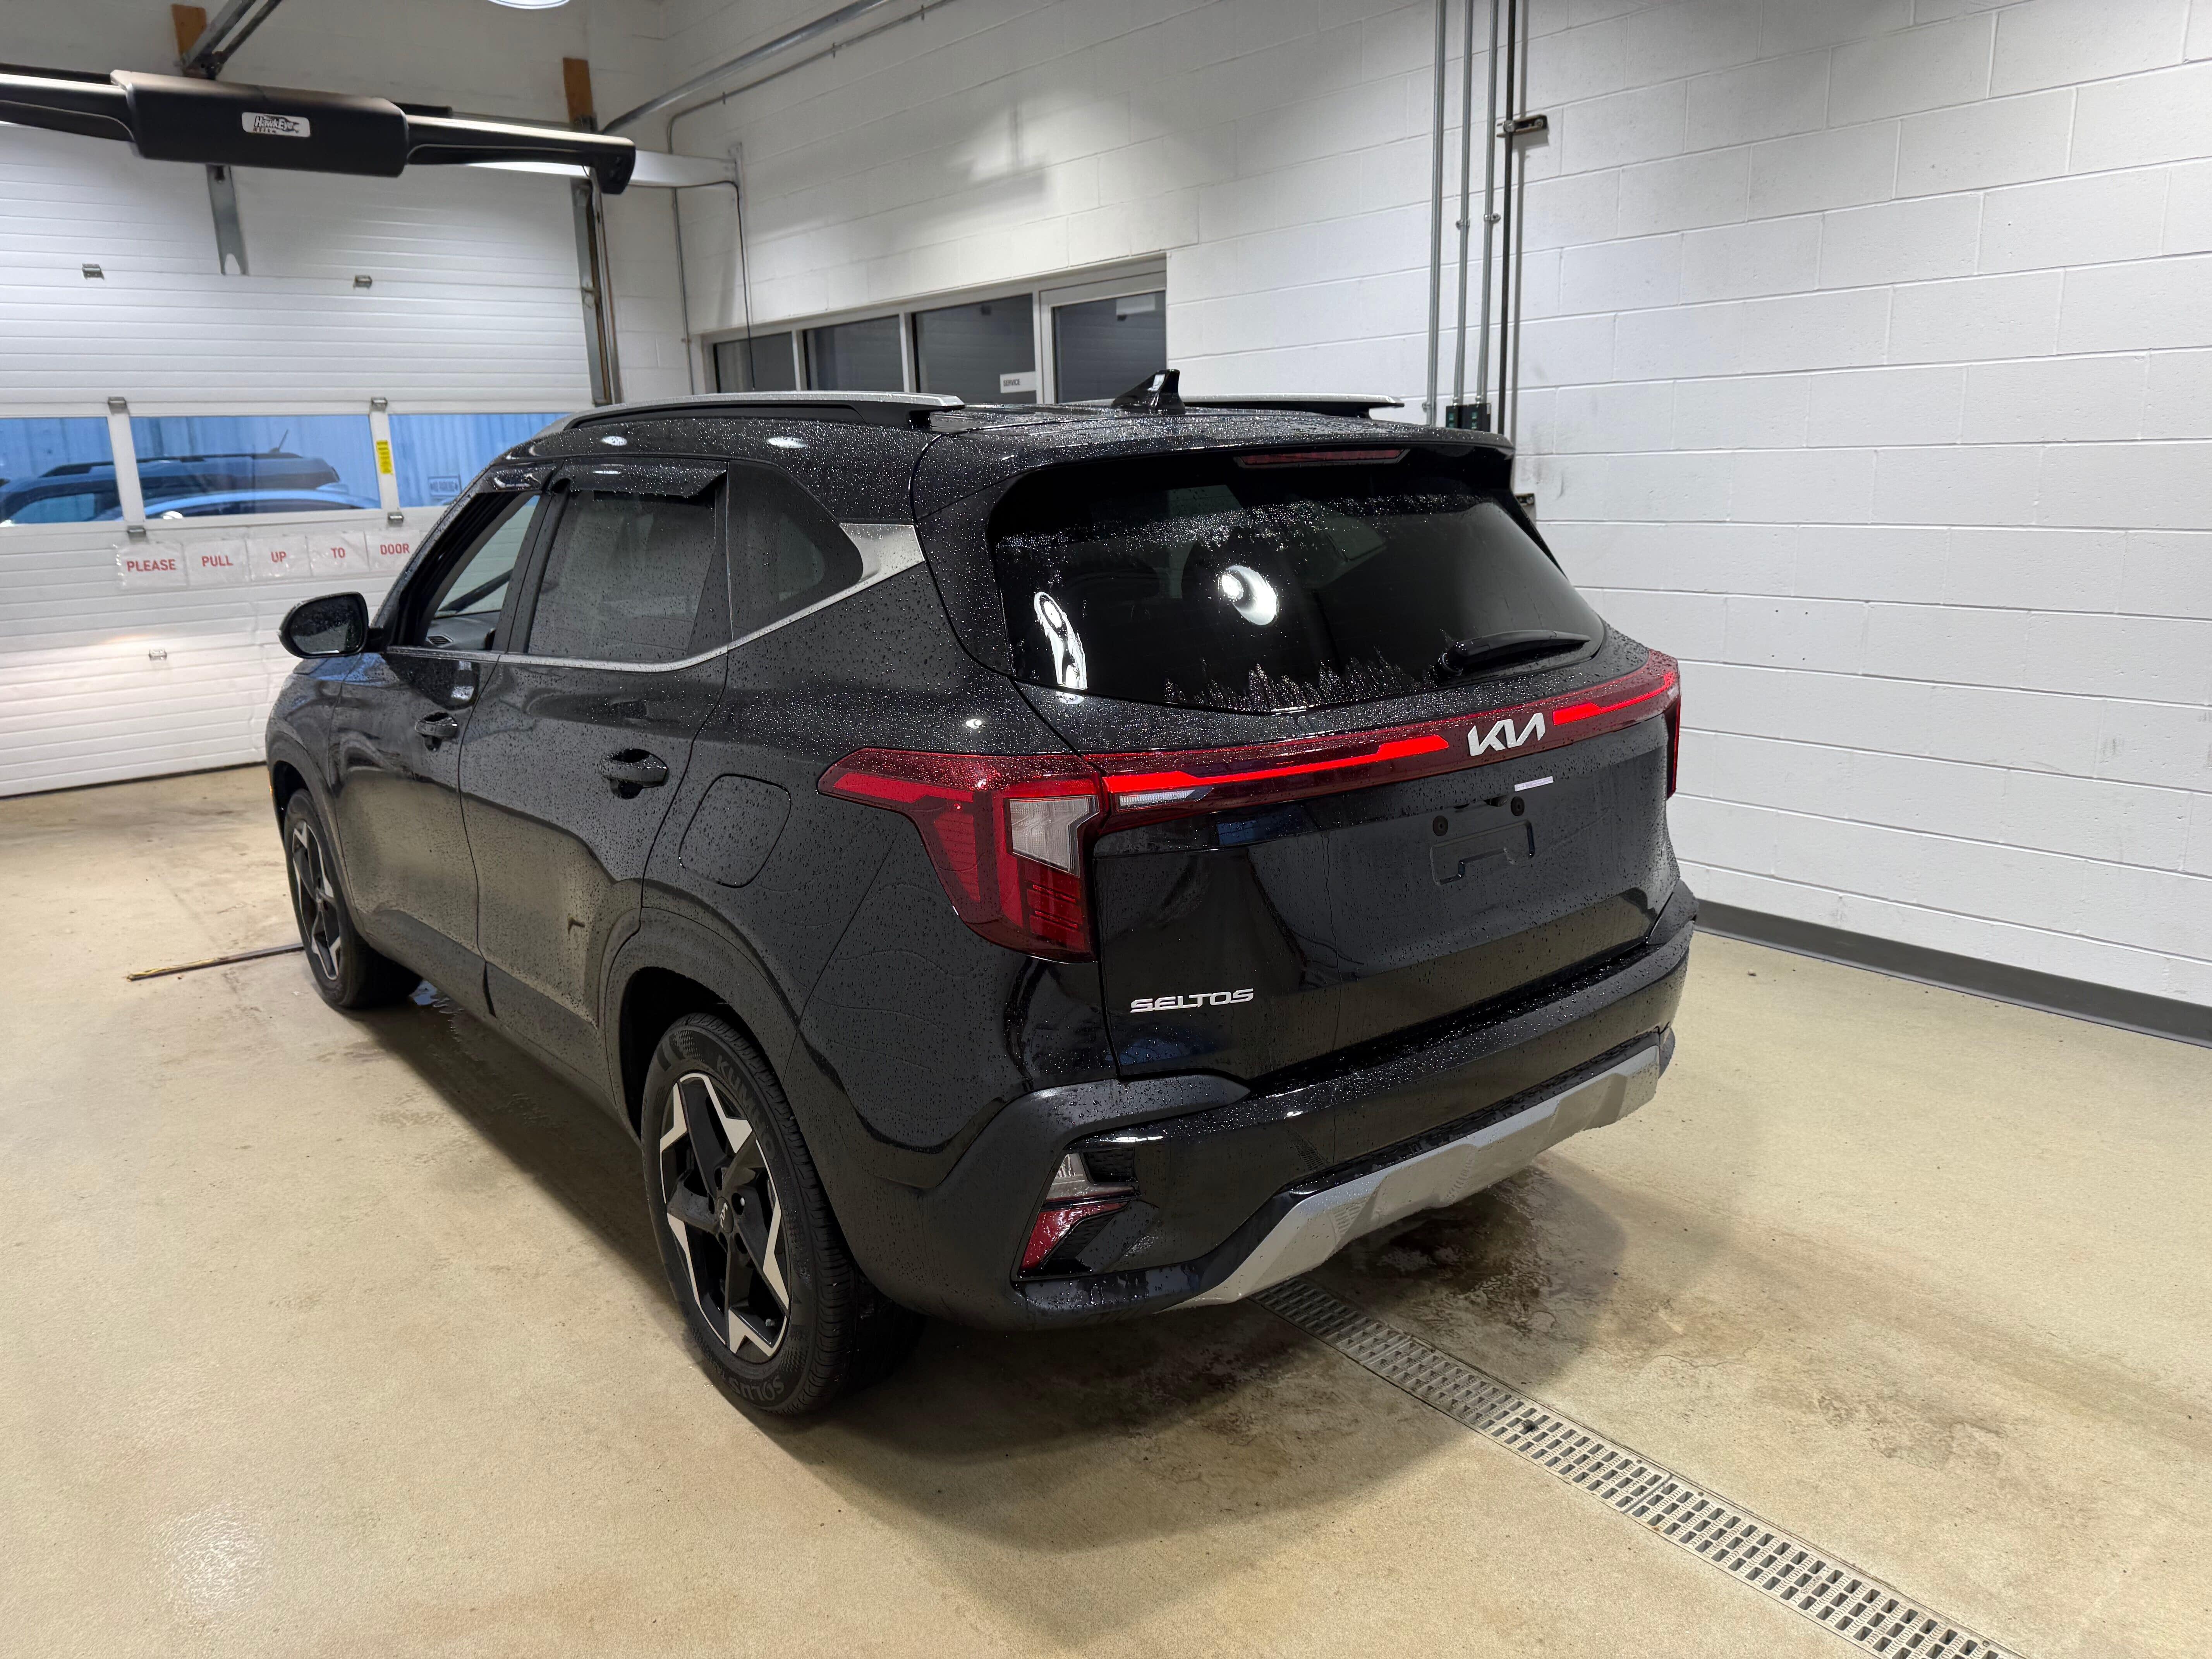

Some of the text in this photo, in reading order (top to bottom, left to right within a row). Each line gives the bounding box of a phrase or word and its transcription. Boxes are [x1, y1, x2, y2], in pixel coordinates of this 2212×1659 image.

[1003, 378, 1020, 386] SERVICE
[127, 543, 410, 572] PLEASE PULL UP TO DOOR
[1467, 712, 1546, 756] KIA
[1130, 988, 1254, 1013] SELTOS
